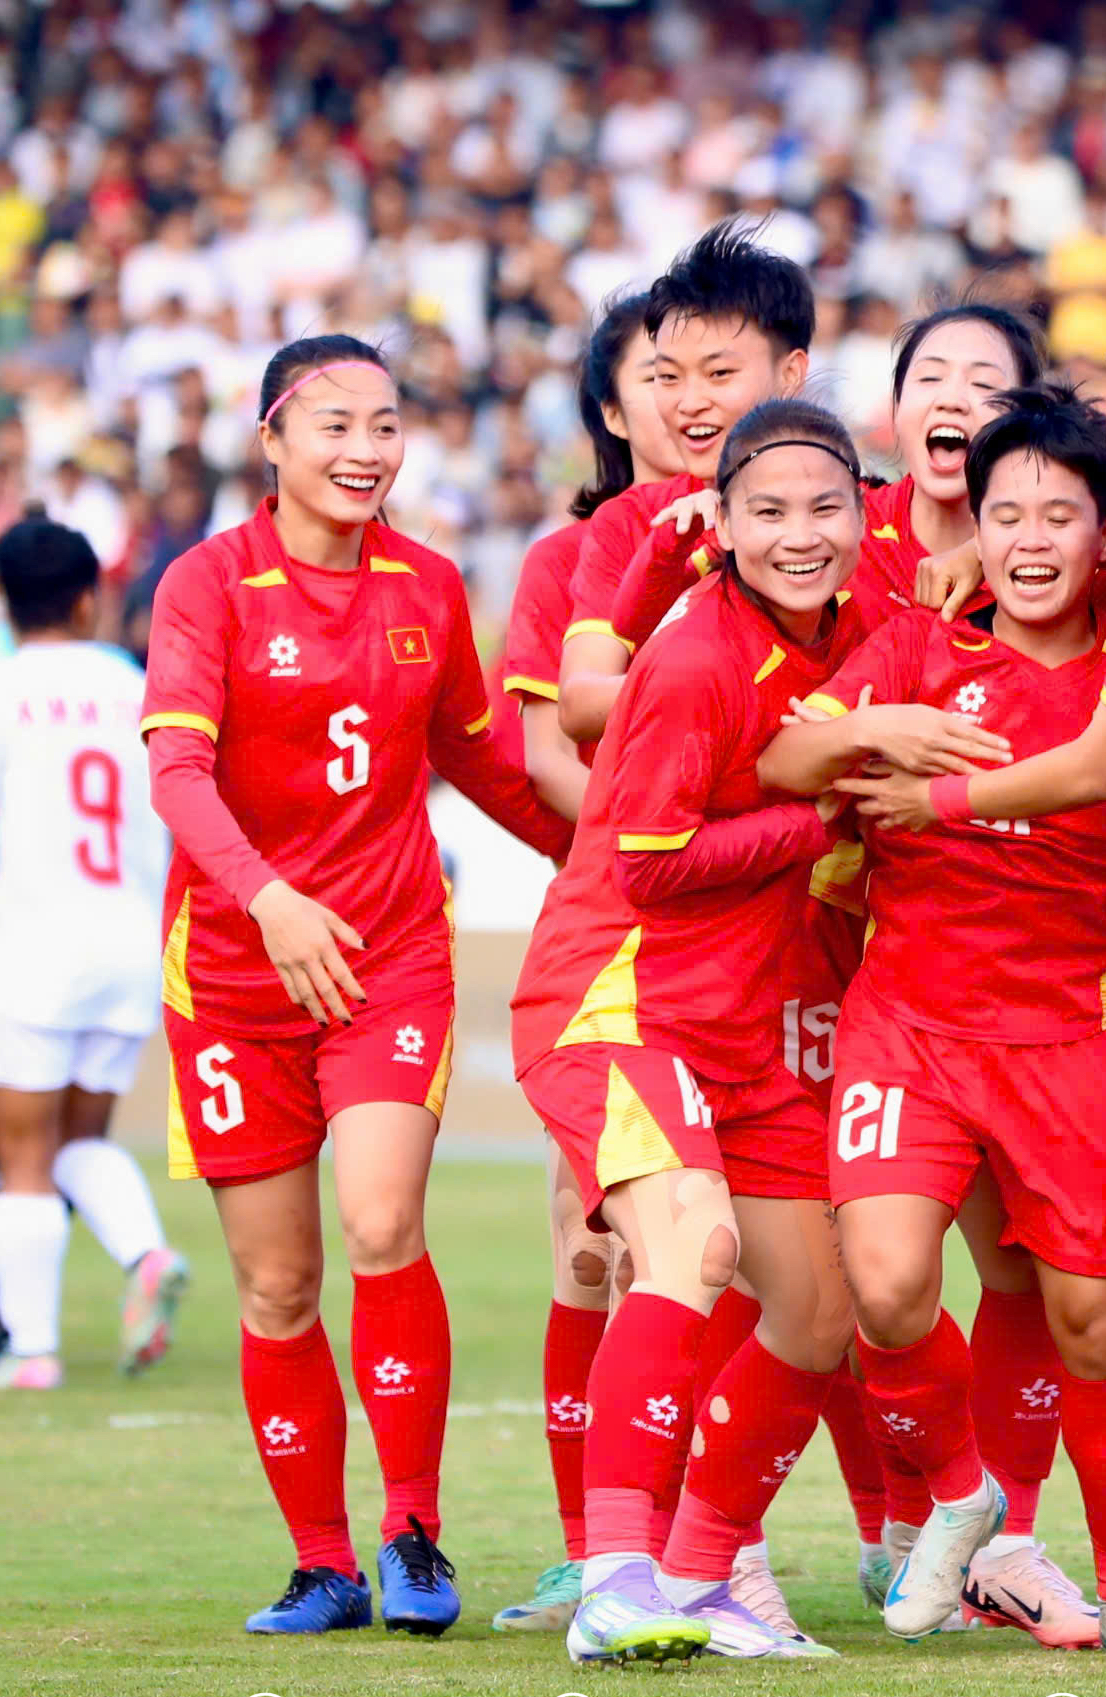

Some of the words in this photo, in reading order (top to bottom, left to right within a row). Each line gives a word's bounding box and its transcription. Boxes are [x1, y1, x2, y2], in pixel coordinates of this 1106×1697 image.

[326, 703, 371, 795] 5
[68, 745, 122, 888] 9
[782, 998, 841, 1084] 15
[195, 1042, 246, 1134] 5
[837, 1081, 905, 1163] 21
